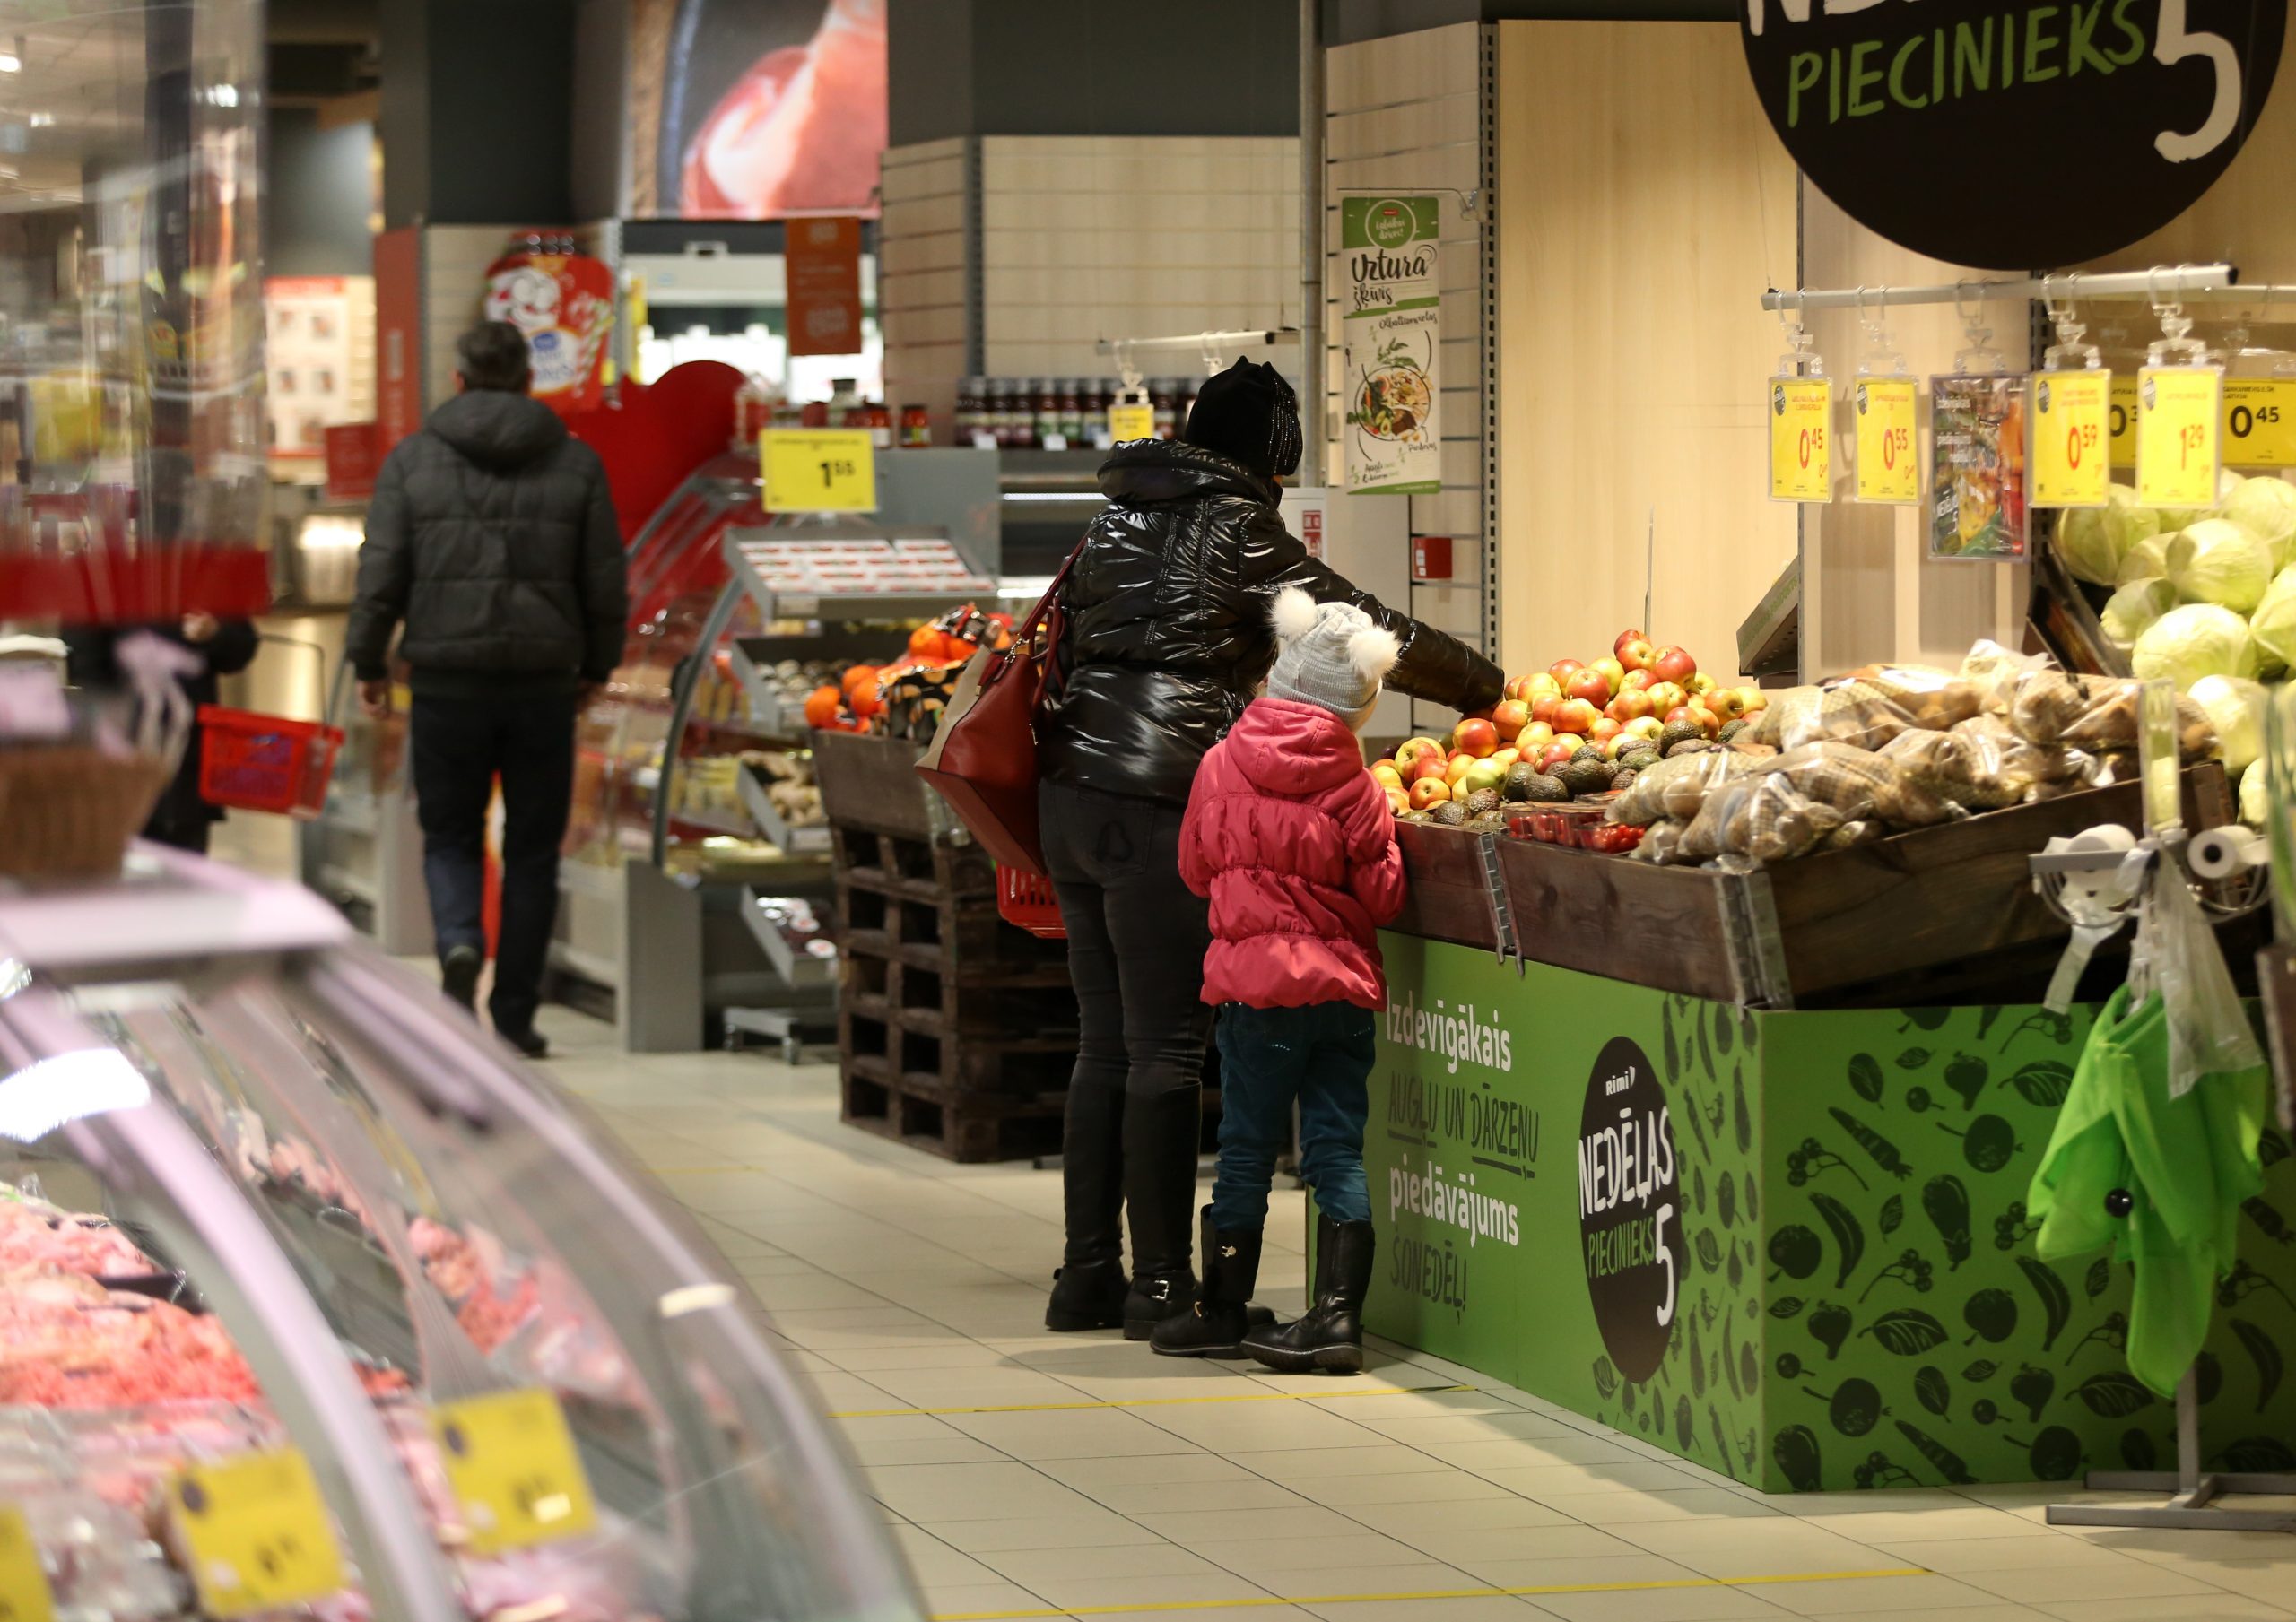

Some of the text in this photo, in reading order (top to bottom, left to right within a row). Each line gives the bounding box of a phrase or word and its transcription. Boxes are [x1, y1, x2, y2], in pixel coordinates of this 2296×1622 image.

[1787, 0, 2242, 164] PIECINIEKS 5
[1352, 248, 1429, 282] Uztura
[1386, 986, 1512, 1074] Izdevīgākais
[1445, 1086, 1465, 1141] UN
[1469, 1082, 1540, 1180] DĀRZEŅU
[1578, 1106, 1674, 1220] NEDĒĻAS
[1390, 1152, 1519, 1248] piedāvājums
[1587, 1203, 1675, 1327] PIECINIEKS 5
